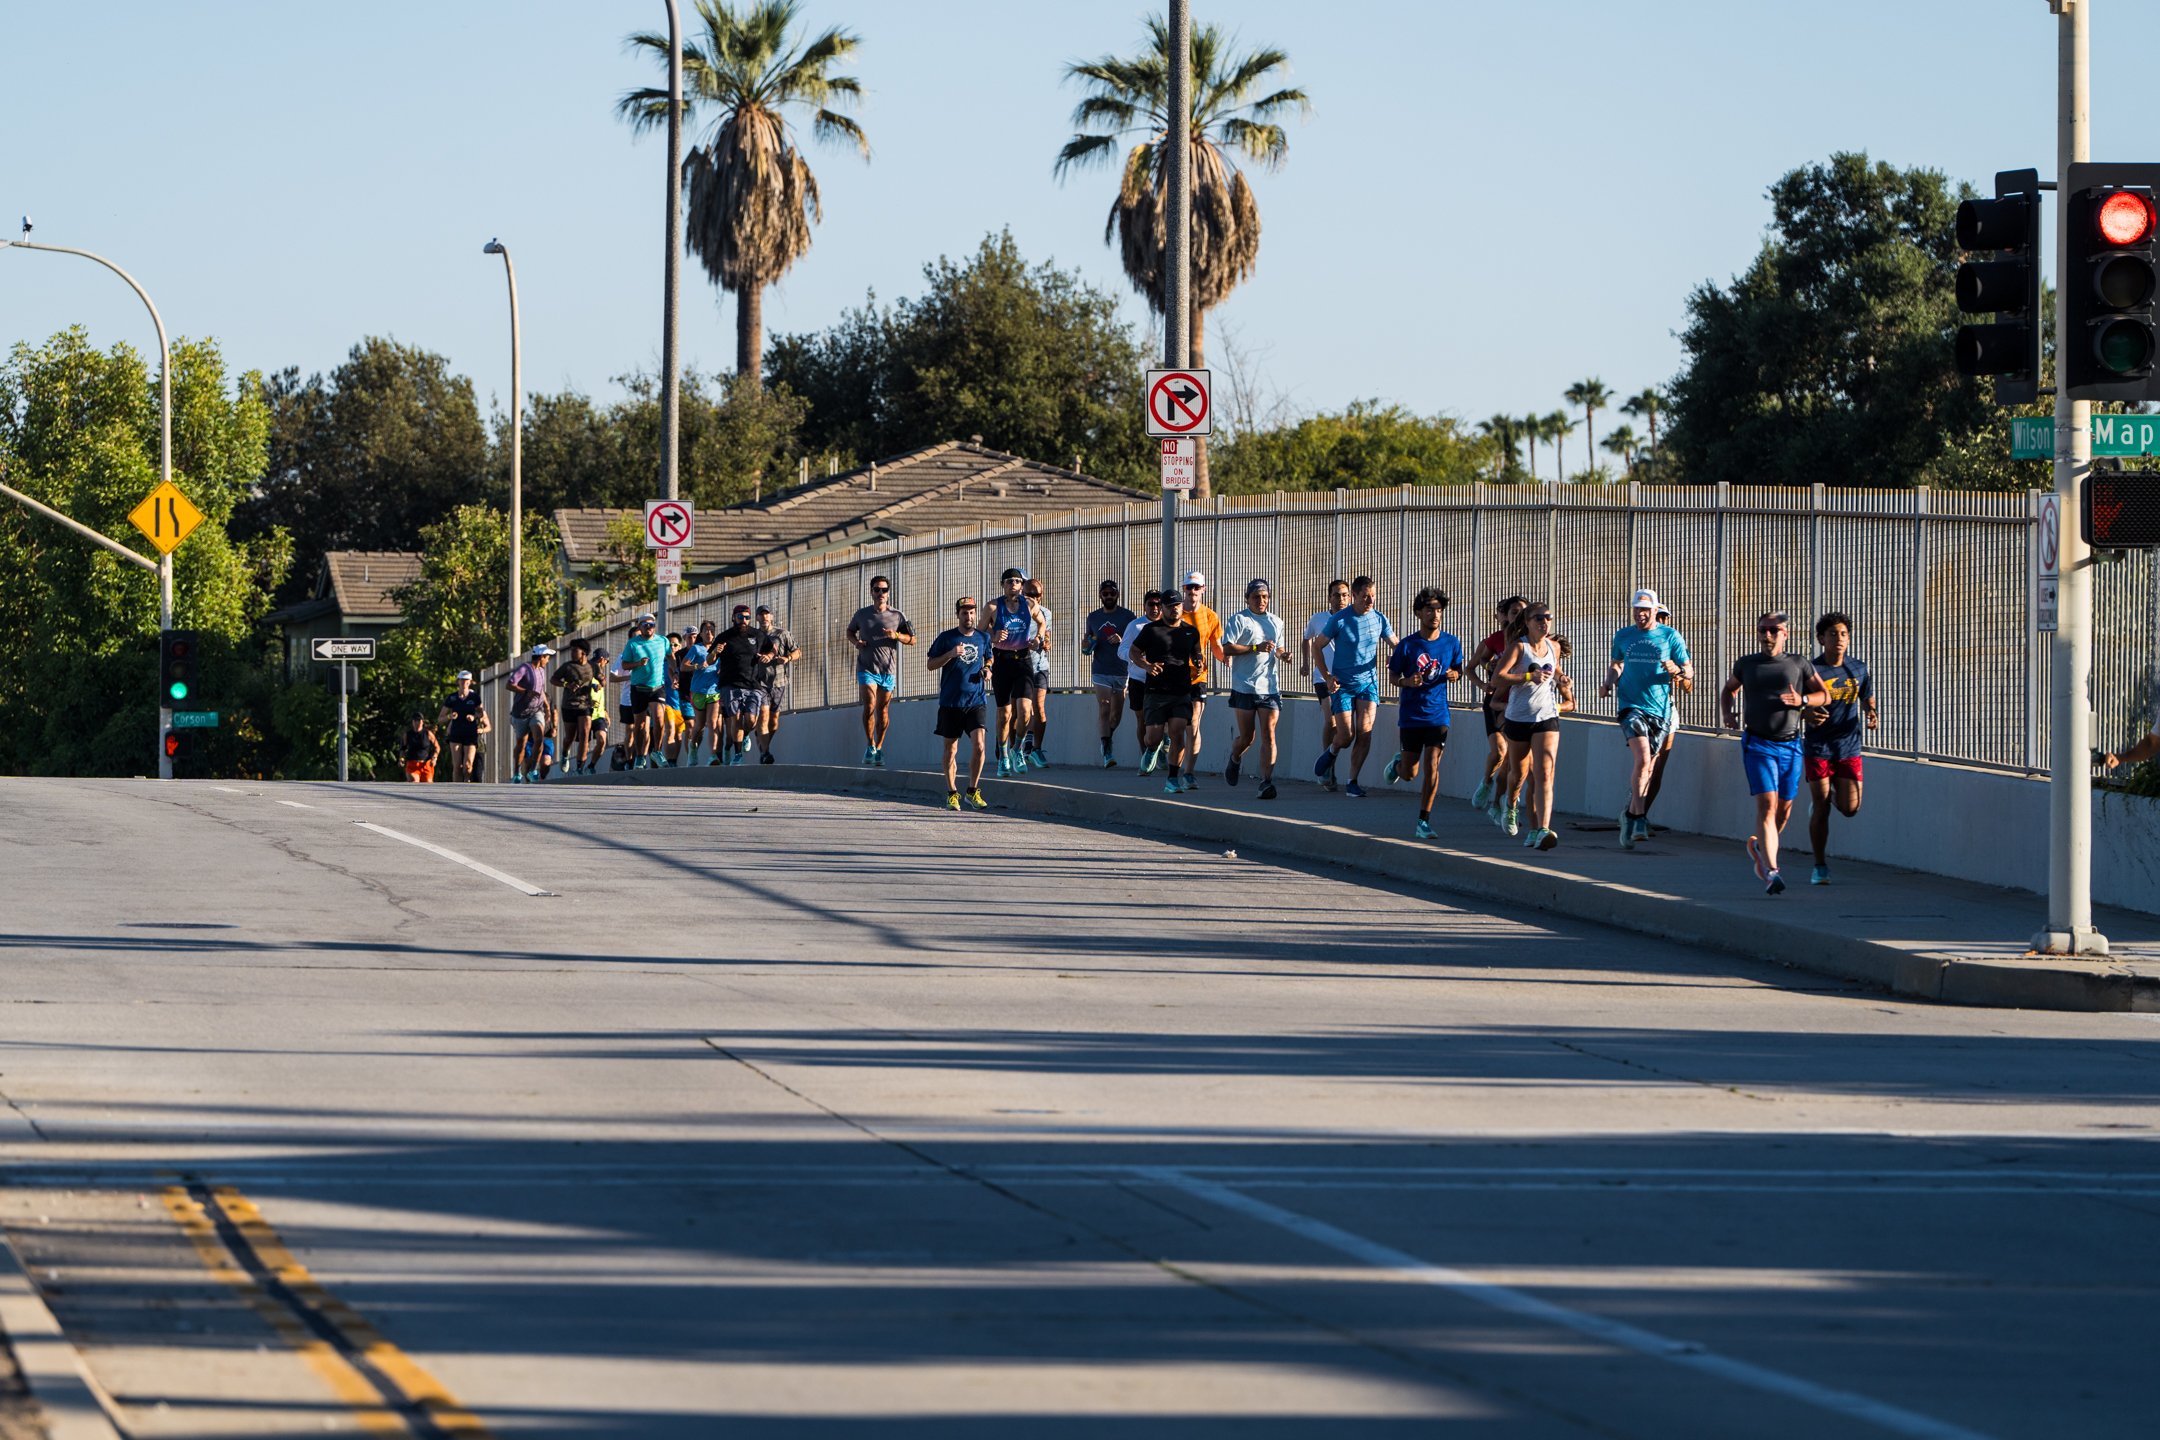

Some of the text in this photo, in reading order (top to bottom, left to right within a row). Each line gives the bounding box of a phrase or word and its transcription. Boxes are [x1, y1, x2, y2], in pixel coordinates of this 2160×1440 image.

[2013, 421, 2051, 450] Wilson
[2095, 418, 2154, 452] Map
[1164, 441, 1176, 453] NO
[1163, 456, 1193, 465] STOPPING
[658, 549, 666, 558] NO
[331, 645, 368, 653] ONE WAY
[173, 713, 206, 724] Corson
